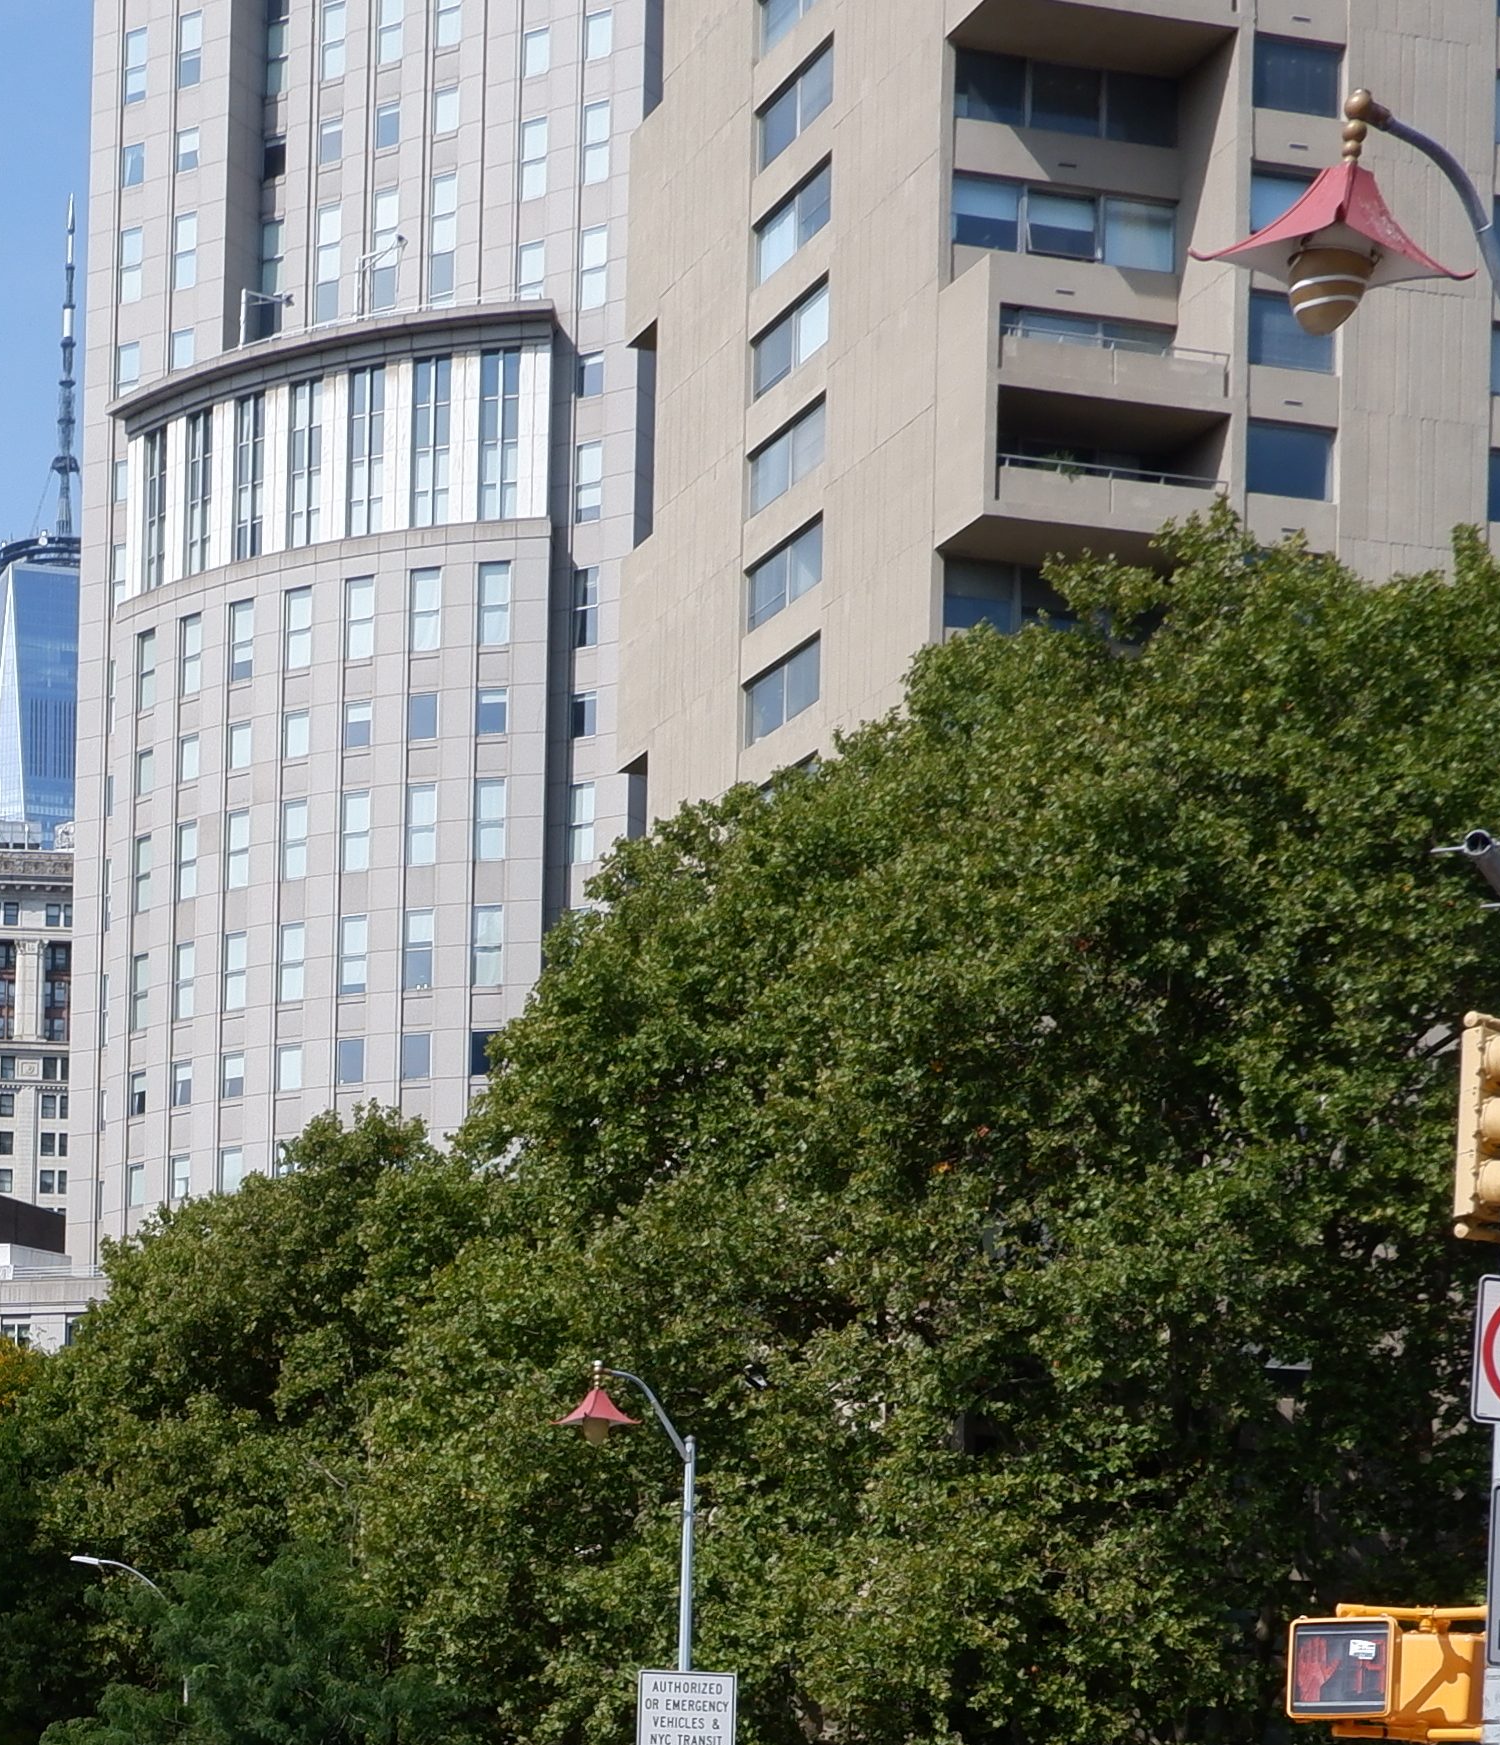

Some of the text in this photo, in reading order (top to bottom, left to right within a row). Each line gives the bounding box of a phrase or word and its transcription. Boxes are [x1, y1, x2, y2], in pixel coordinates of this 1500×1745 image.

[652, 1681, 723, 1695] AUTHORIZED
[645, 1698, 729, 1712] OR EMERGENCY
[653, 1716, 720, 1730] VEHICLES &
[650, 1734, 672, 1745] NYC
